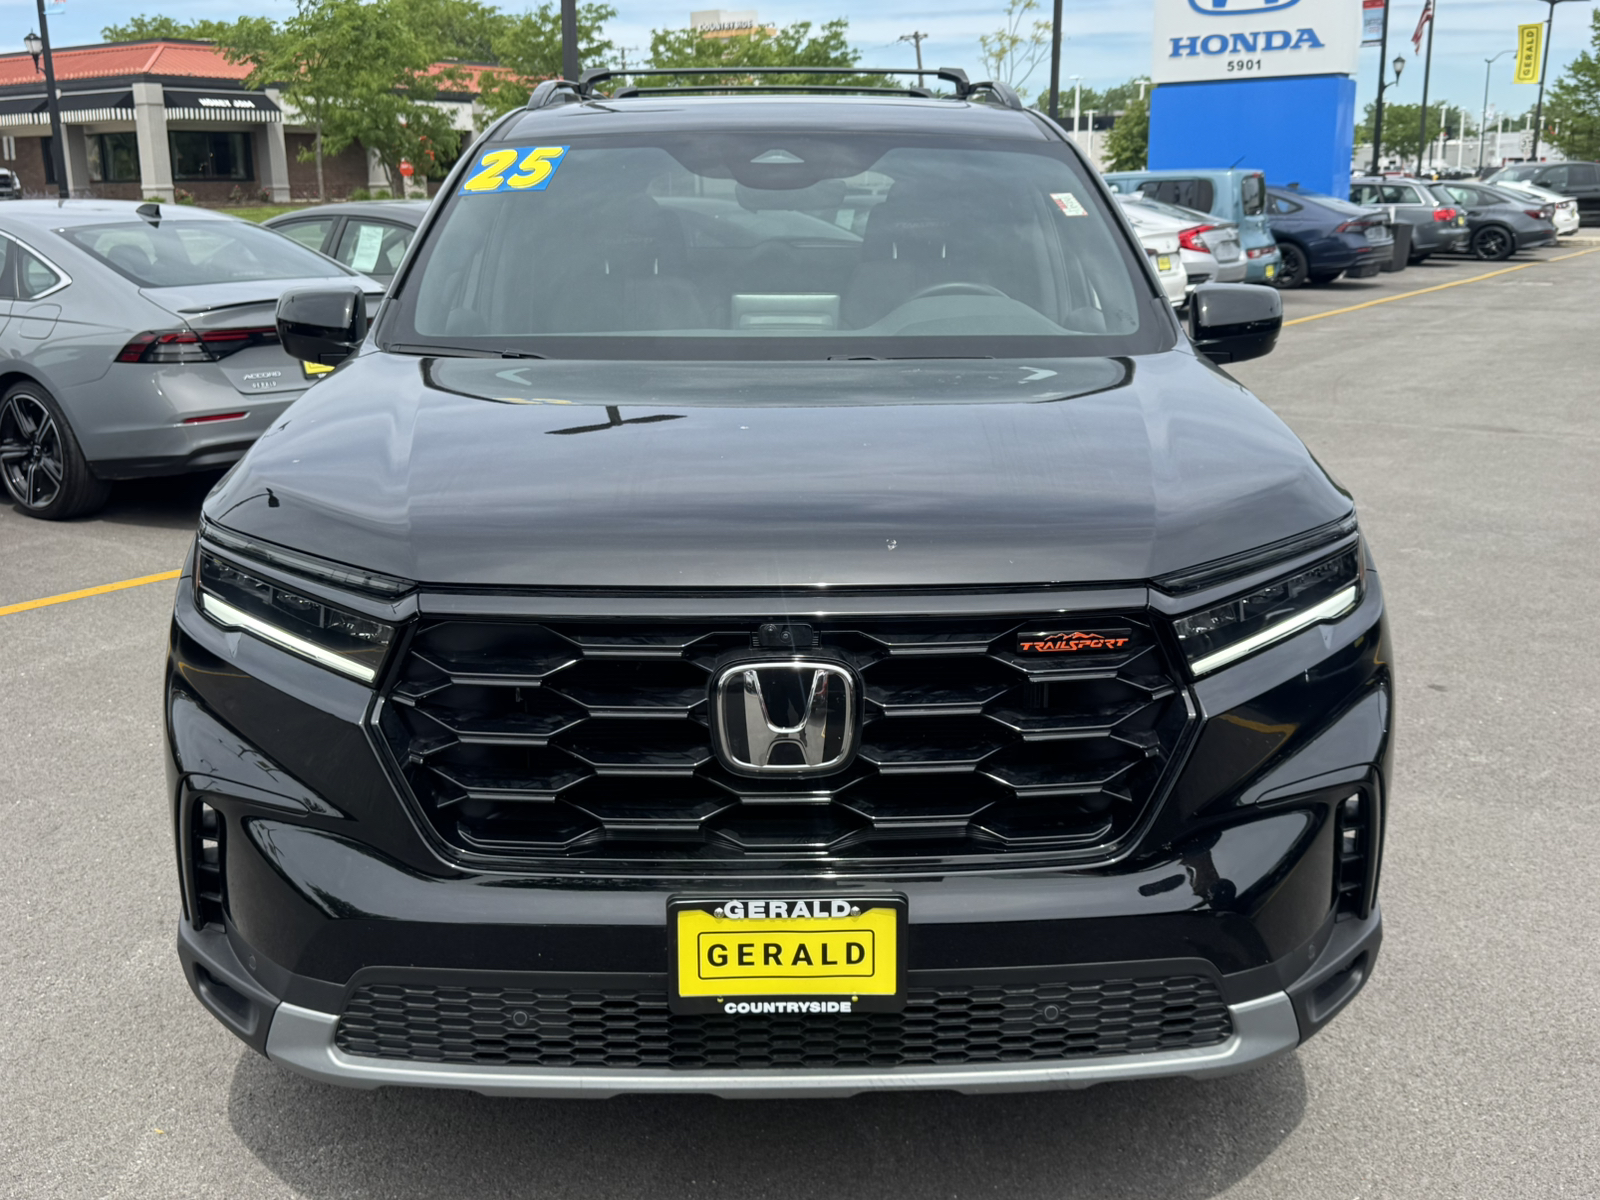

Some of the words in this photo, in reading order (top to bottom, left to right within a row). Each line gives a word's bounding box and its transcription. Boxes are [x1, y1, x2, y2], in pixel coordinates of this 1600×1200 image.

[1169, 28, 1325, 58] HONDA
[1523, 30, 1535, 76] GERALD
[1227, 59, 1262, 72] 5901
[464, 146, 565, 192] 25
[243, 370, 282, 381] ACCORD
[1020, 638, 1129, 652] TRAILSPORT
[723, 900, 852, 919] GERALD
[707, 942, 866, 967] GERALD
[724, 1001, 852, 1014] COUNTRYSIDE
